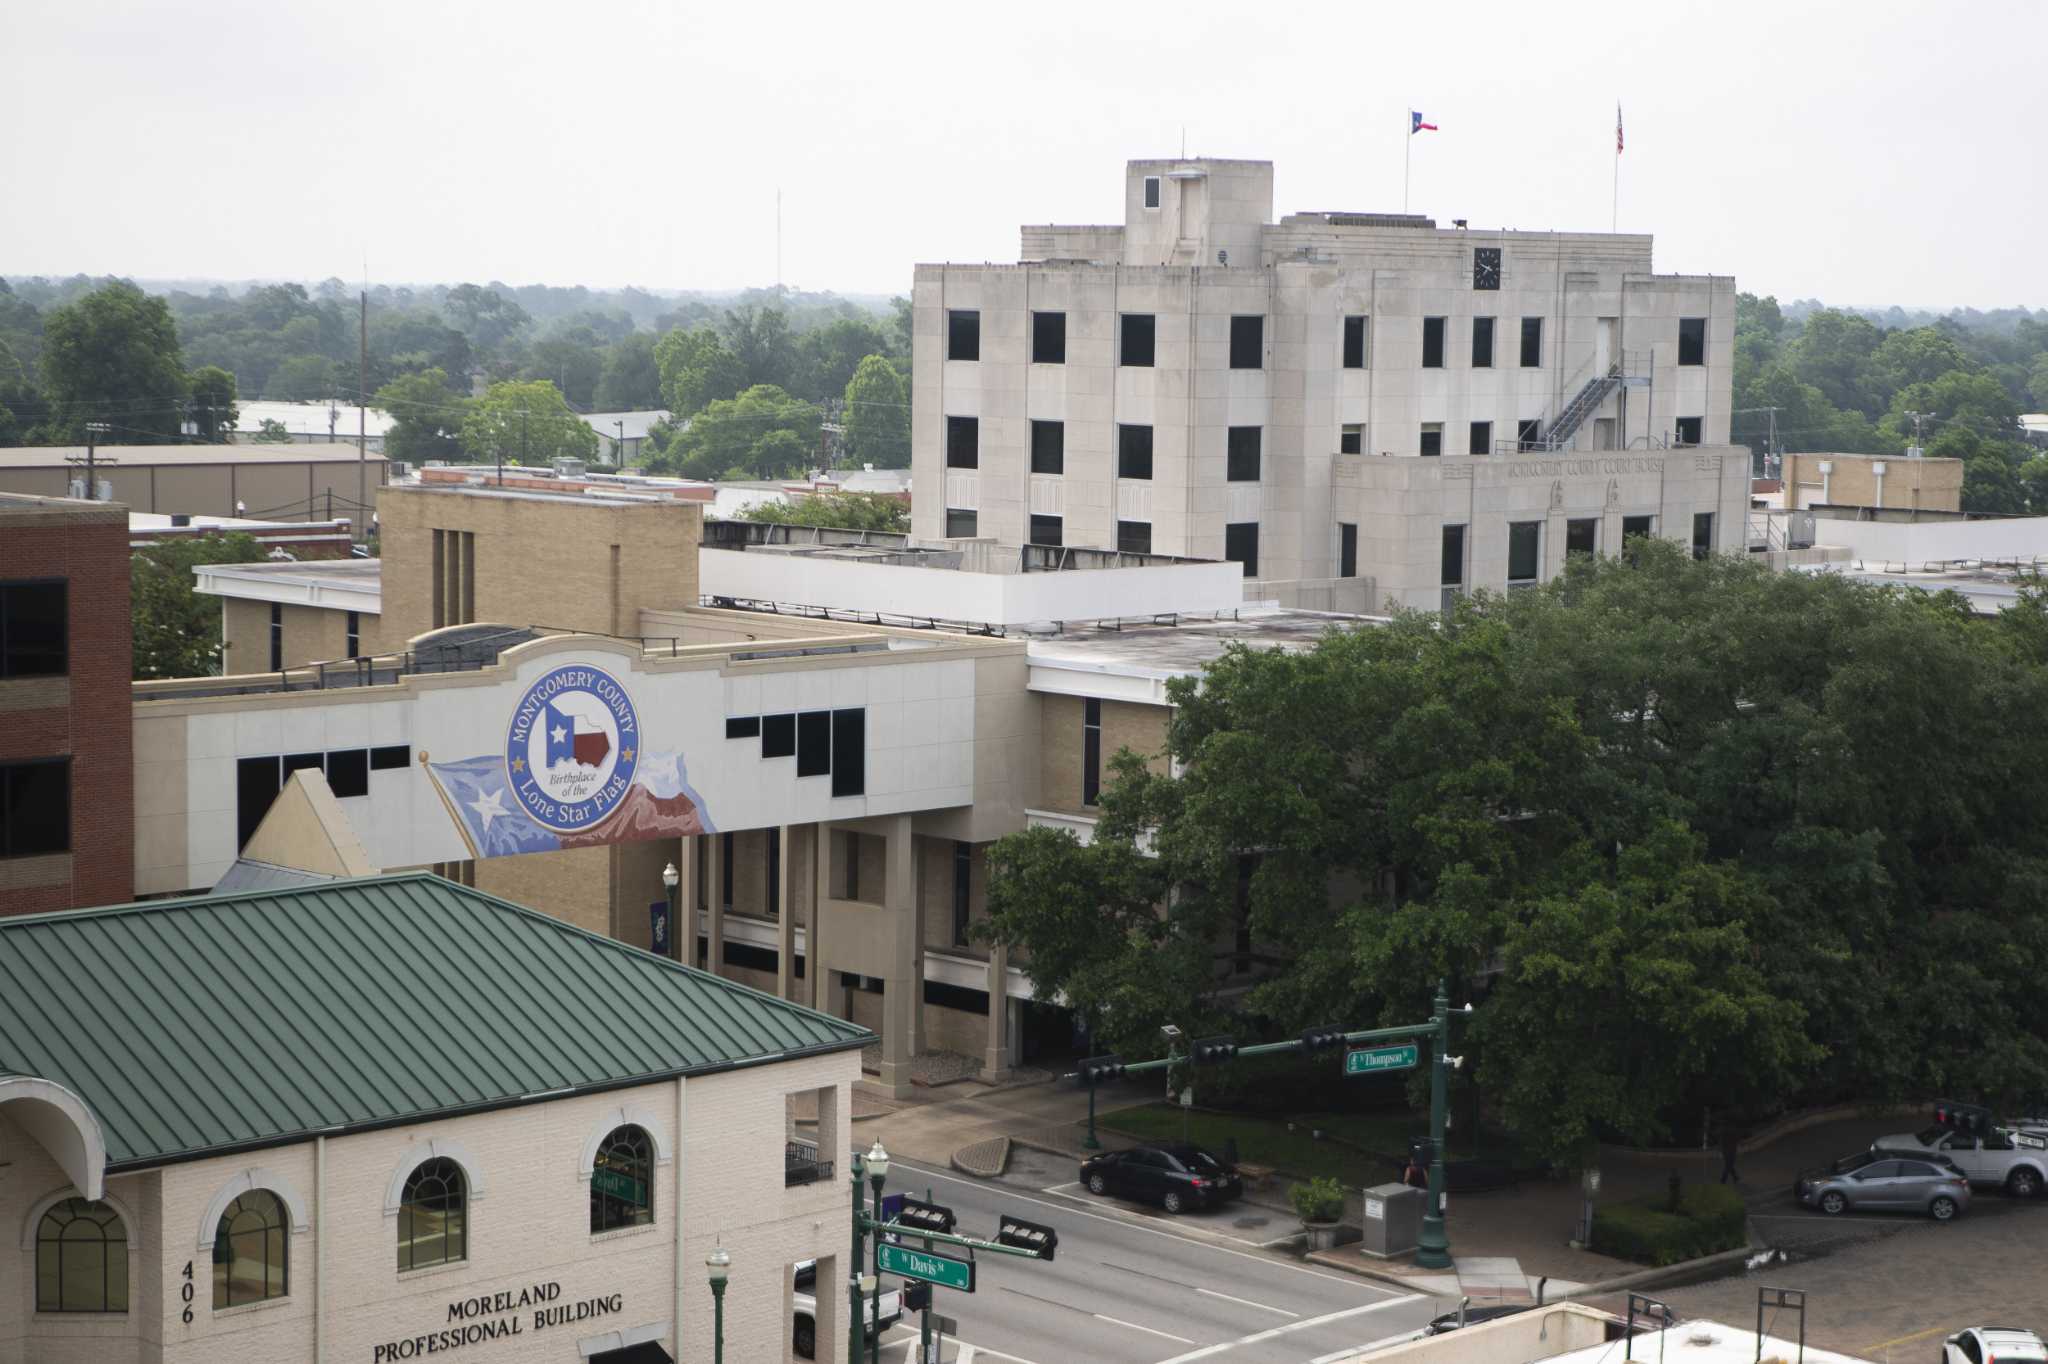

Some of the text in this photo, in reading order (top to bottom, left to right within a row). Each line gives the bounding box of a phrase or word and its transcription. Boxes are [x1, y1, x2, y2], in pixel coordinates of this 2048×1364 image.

[513, 672, 634, 743] MONTGOMERY COUNTY
[520, 773, 626, 823] Lone Star Flag
[550, 772, 597, 785] Birthplace
[561, 785, 588, 797] of the
[1365, 1053, 1401, 1067] Thompson
[910, 1255, 937, 1276] Davis
[937, 1261, 945, 1272] St
[182, 1260, 194, 1324] 406
[447, 1282, 561, 1322] MORELAND
[374, 1293, 623, 1364] PROFESSIONAL BUILDING
